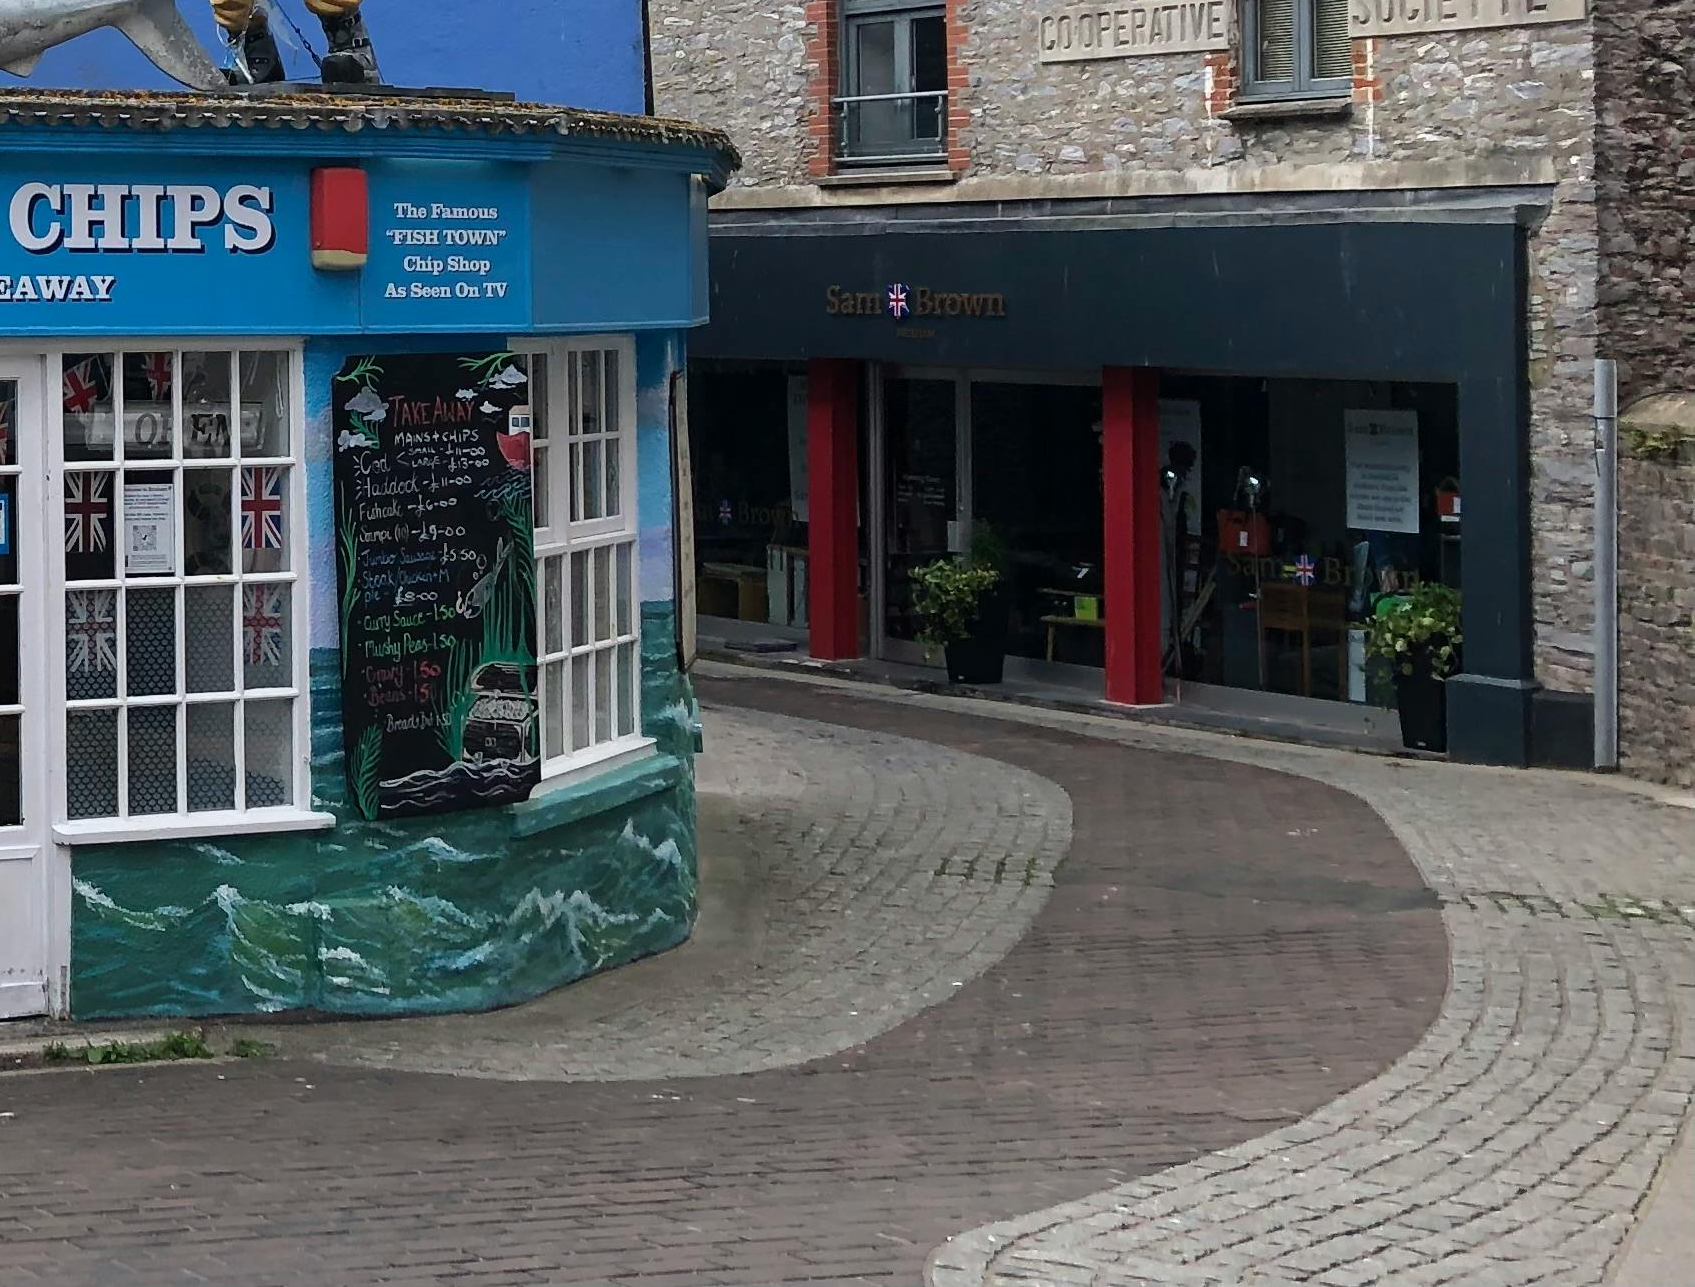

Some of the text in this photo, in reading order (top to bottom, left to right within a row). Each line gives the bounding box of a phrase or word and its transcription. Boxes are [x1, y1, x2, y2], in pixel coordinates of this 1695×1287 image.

[8, 183, 274, 252] CHIPS
[393, 202, 498, 220] The Famous
[403, 255, 491, 275] Chip Shop
[384, 281, 508, 299] As Seen On TV
[825, 285, 1007, 317] Sam Brown
[441, 428, 480, 443] CHIPS
[360, 450, 391, 475] Cod
